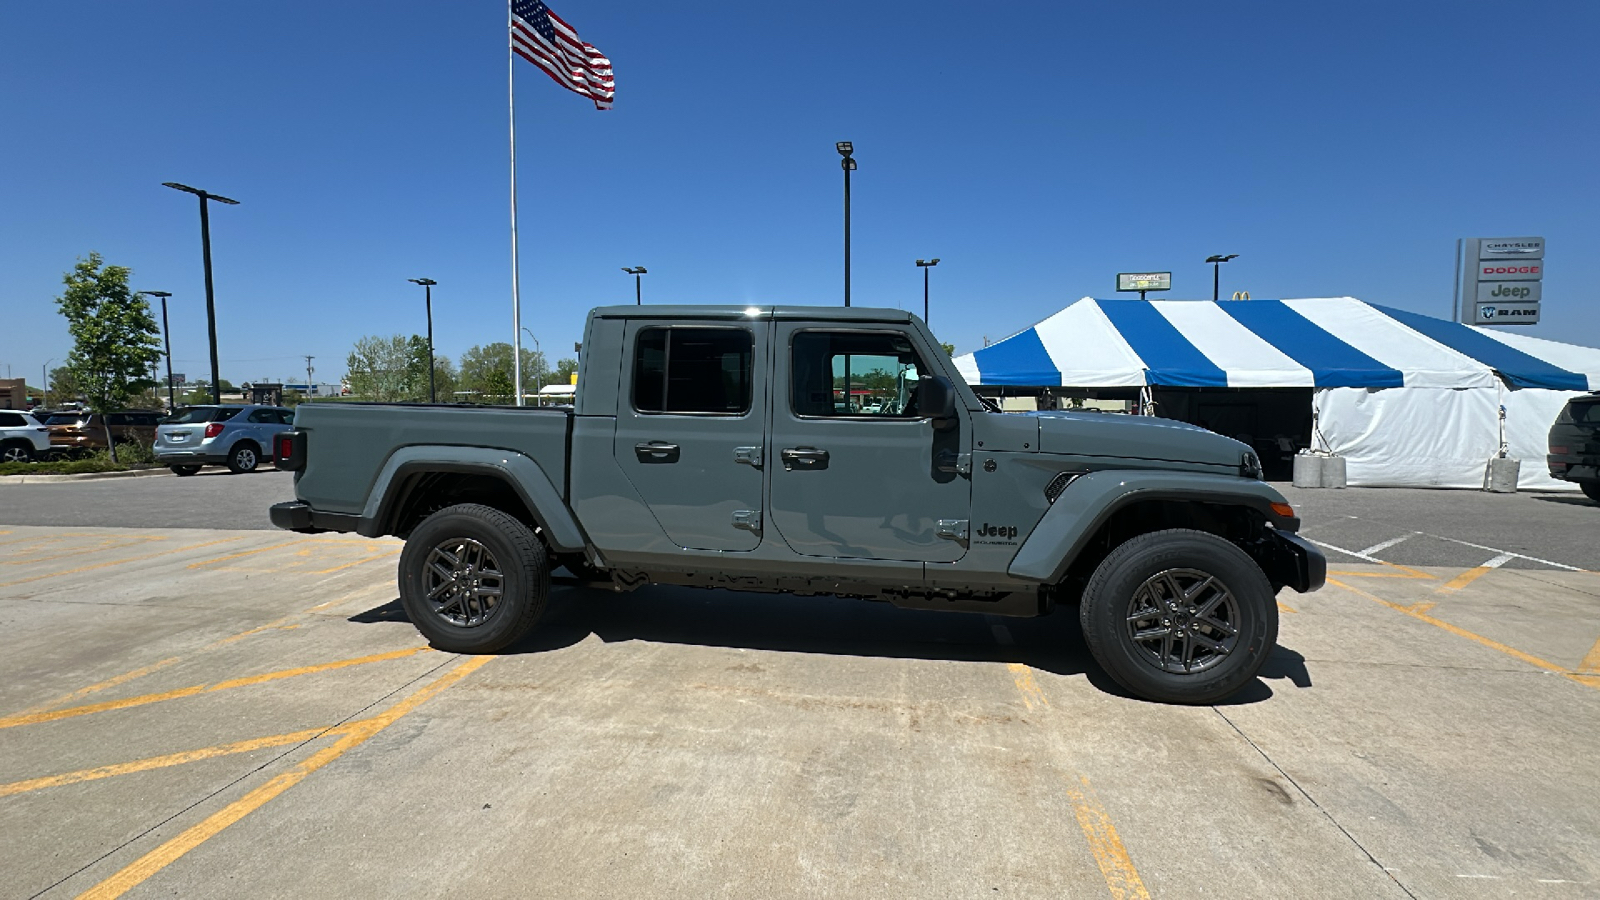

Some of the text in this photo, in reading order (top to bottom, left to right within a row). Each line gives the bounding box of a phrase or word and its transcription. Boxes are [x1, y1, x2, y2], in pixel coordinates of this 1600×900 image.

[1483, 266, 1539, 274] DODGE
[1491, 284, 1530, 298] Jeep
[976, 523, 1018, 540] Jeep
